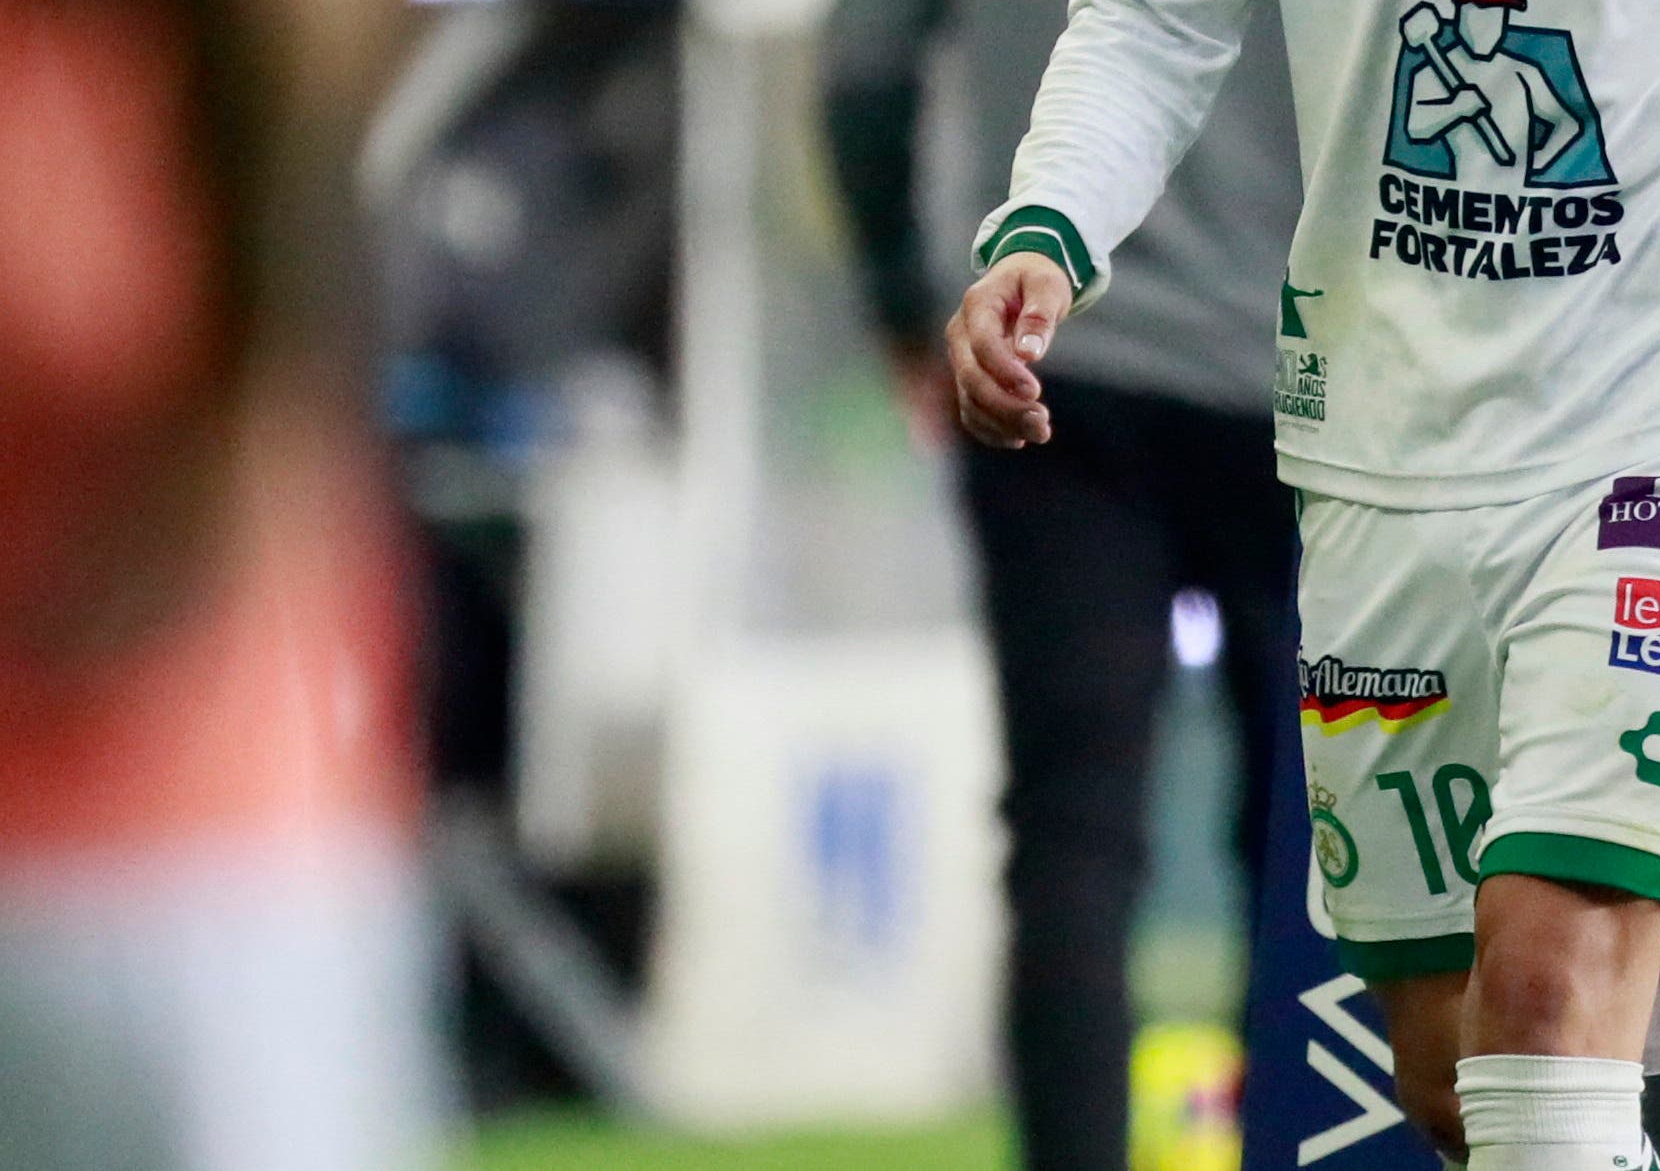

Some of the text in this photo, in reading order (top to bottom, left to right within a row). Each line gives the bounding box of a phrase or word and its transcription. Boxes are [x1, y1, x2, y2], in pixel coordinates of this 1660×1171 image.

[1378, 172, 1625, 235] CEMENTOS
[1369, 218, 1622, 281] FORTALEZA
[1296, 375, 1327, 399] AÑOS
[1311, 656, 1442, 699] Alemana
